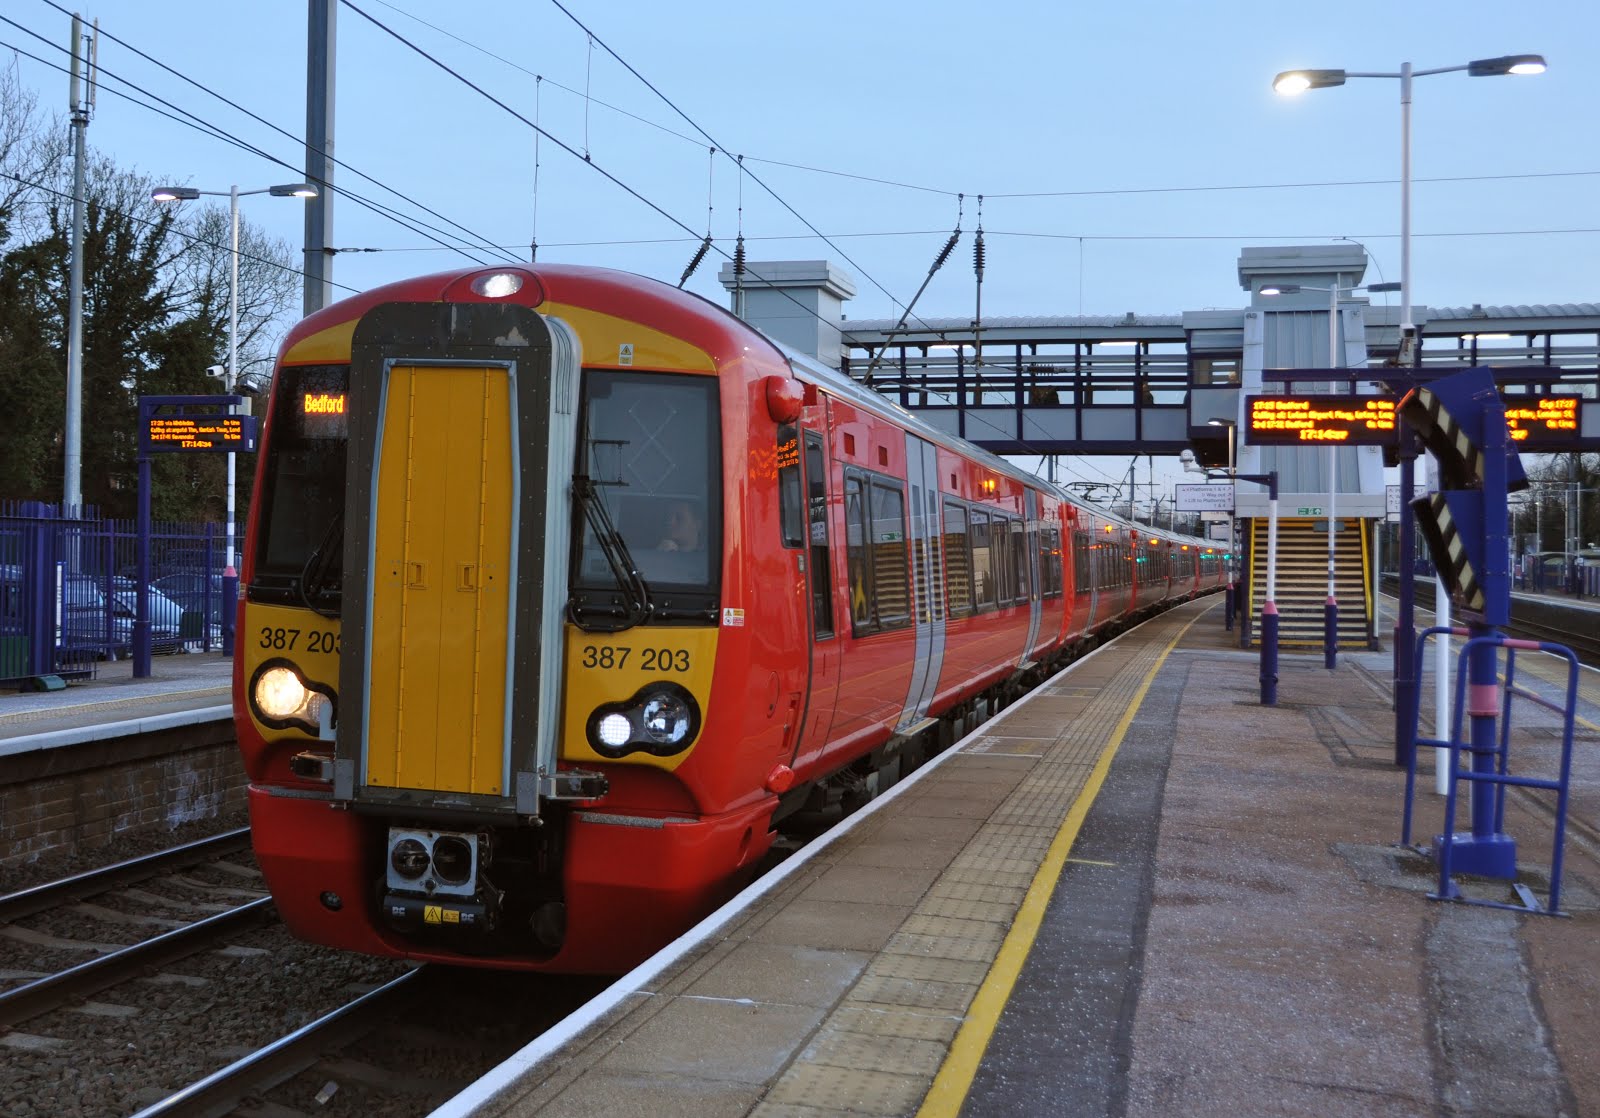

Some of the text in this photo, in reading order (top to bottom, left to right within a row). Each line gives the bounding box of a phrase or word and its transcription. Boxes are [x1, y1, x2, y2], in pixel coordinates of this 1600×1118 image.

[304, 394, 344, 414] Bedford
[1366, 401, 1377, 410] On
[1377, 401, 1394, 410] time
[1539, 399, 1555, 410] Exp
[1537, 409, 1563, 419] London
[1366, 420, 1377, 429] On
[1377, 420, 1394, 429] time
[1546, 419, 1576, 429] On time
[260, 627, 301, 651] 387
[582, 645, 690, 672] 387 203
